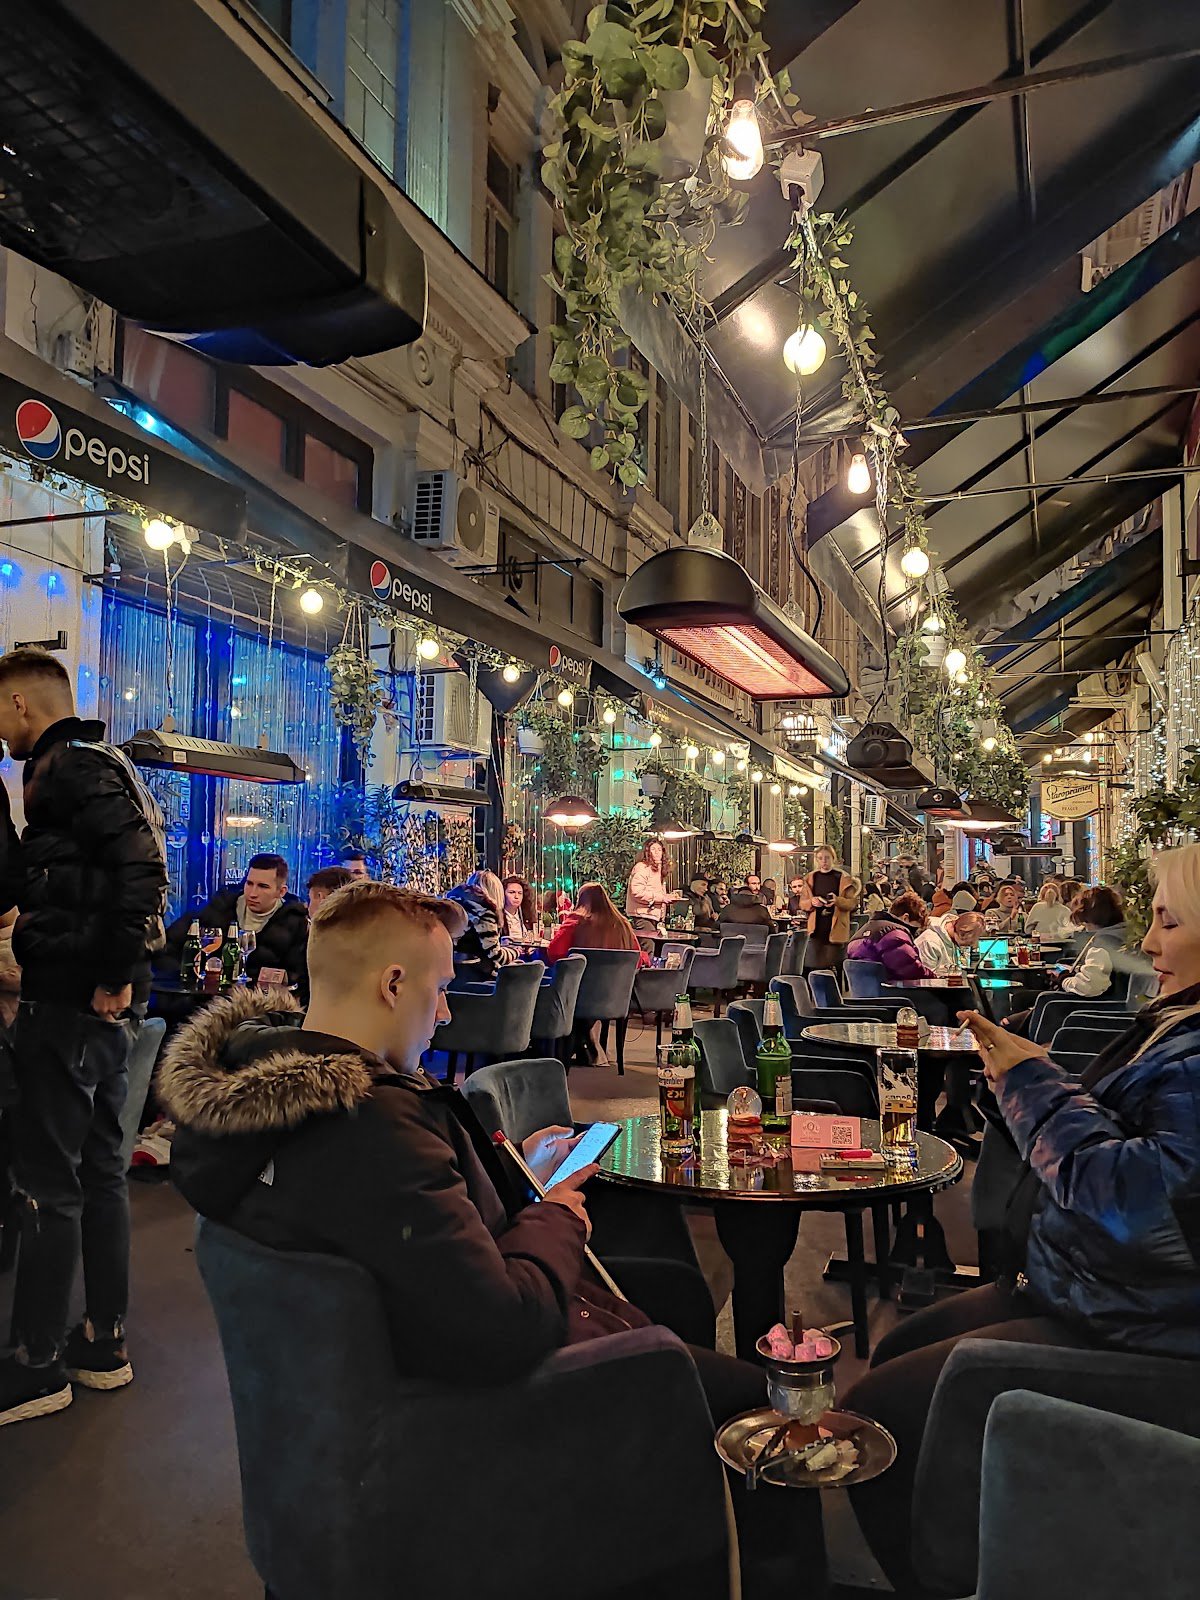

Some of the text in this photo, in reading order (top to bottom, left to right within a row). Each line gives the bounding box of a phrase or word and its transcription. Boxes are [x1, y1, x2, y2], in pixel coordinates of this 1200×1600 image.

[65, 428, 149, 485] pepsi
[392, 578, 432, 614] pepsi
[562, 655, 585, 677] pepsi
[1046, 784, 1094, 801] Staropramen
